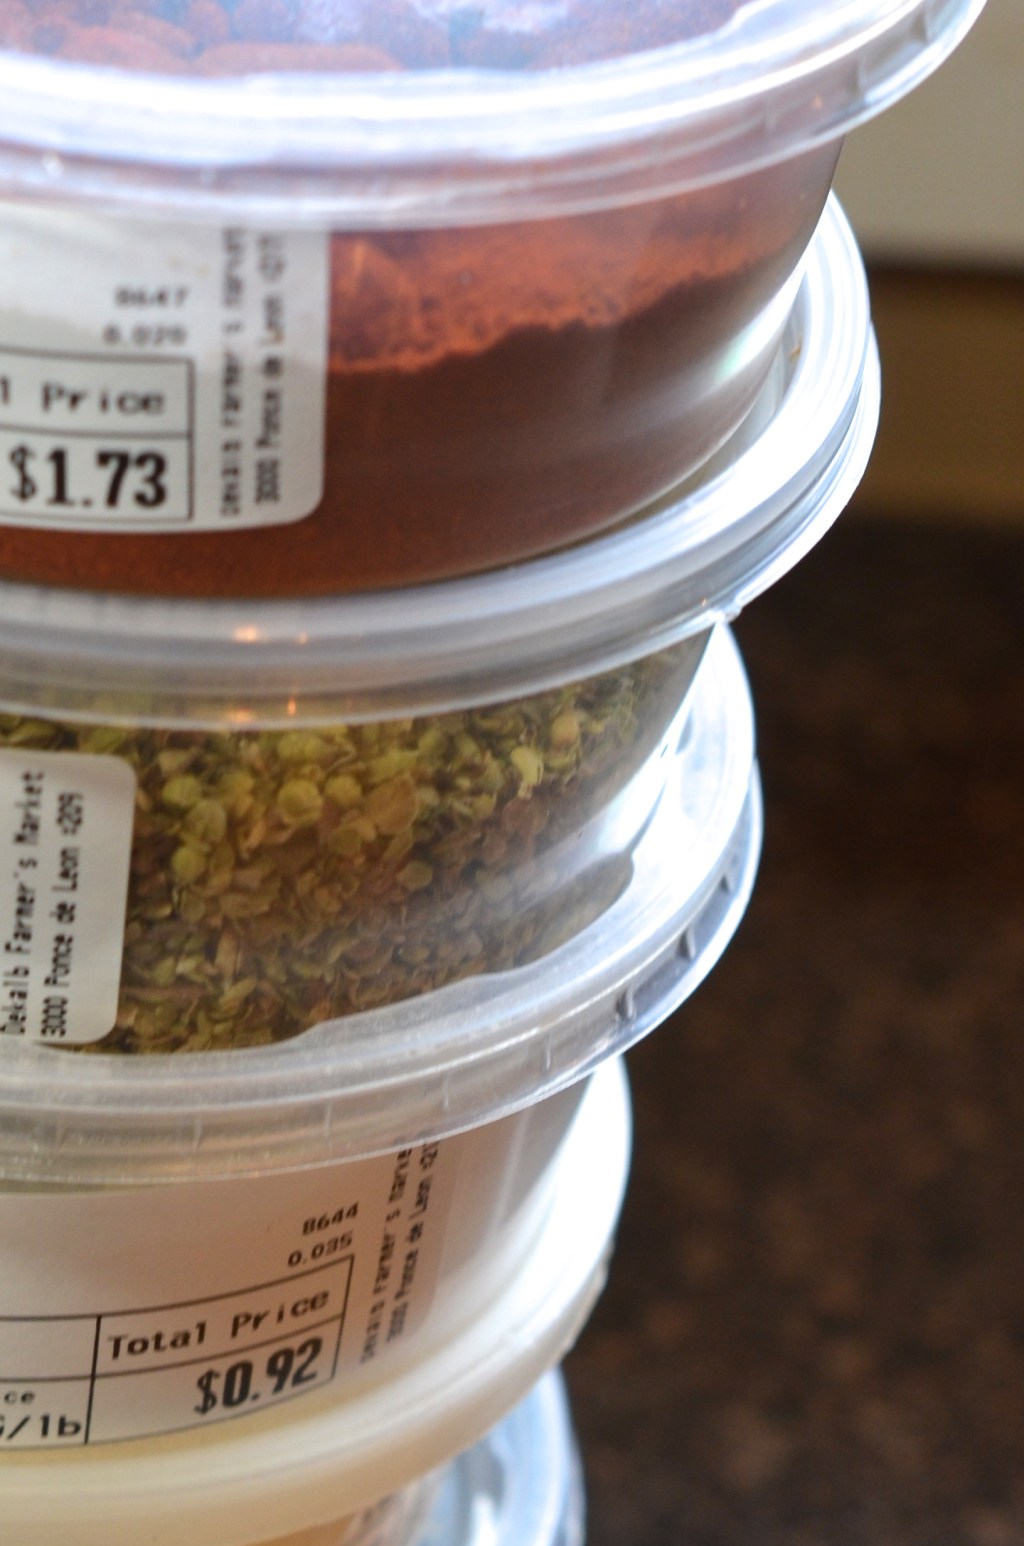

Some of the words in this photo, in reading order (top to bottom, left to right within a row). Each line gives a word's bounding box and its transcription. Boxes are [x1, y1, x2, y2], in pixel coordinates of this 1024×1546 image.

[42, 381, 166, 414] Price
[9, 442, 168, 508] $1.73
[13, 769, 45, 846] Market
[51, 846, 80, 893] Leon
[49, 901, 77, 925] de
[43, 932, 73, 988] Ponce
[40, 995, 69, 1038] 3000
[302, 1201, 360, 1236] 8644
[287, 1230, 354, 1268] 0.035
[107, 1319, 208, 1362] Total
[231, 1291, 330, 1340] Price
[193, 1336, 324, 1416] $0.92
